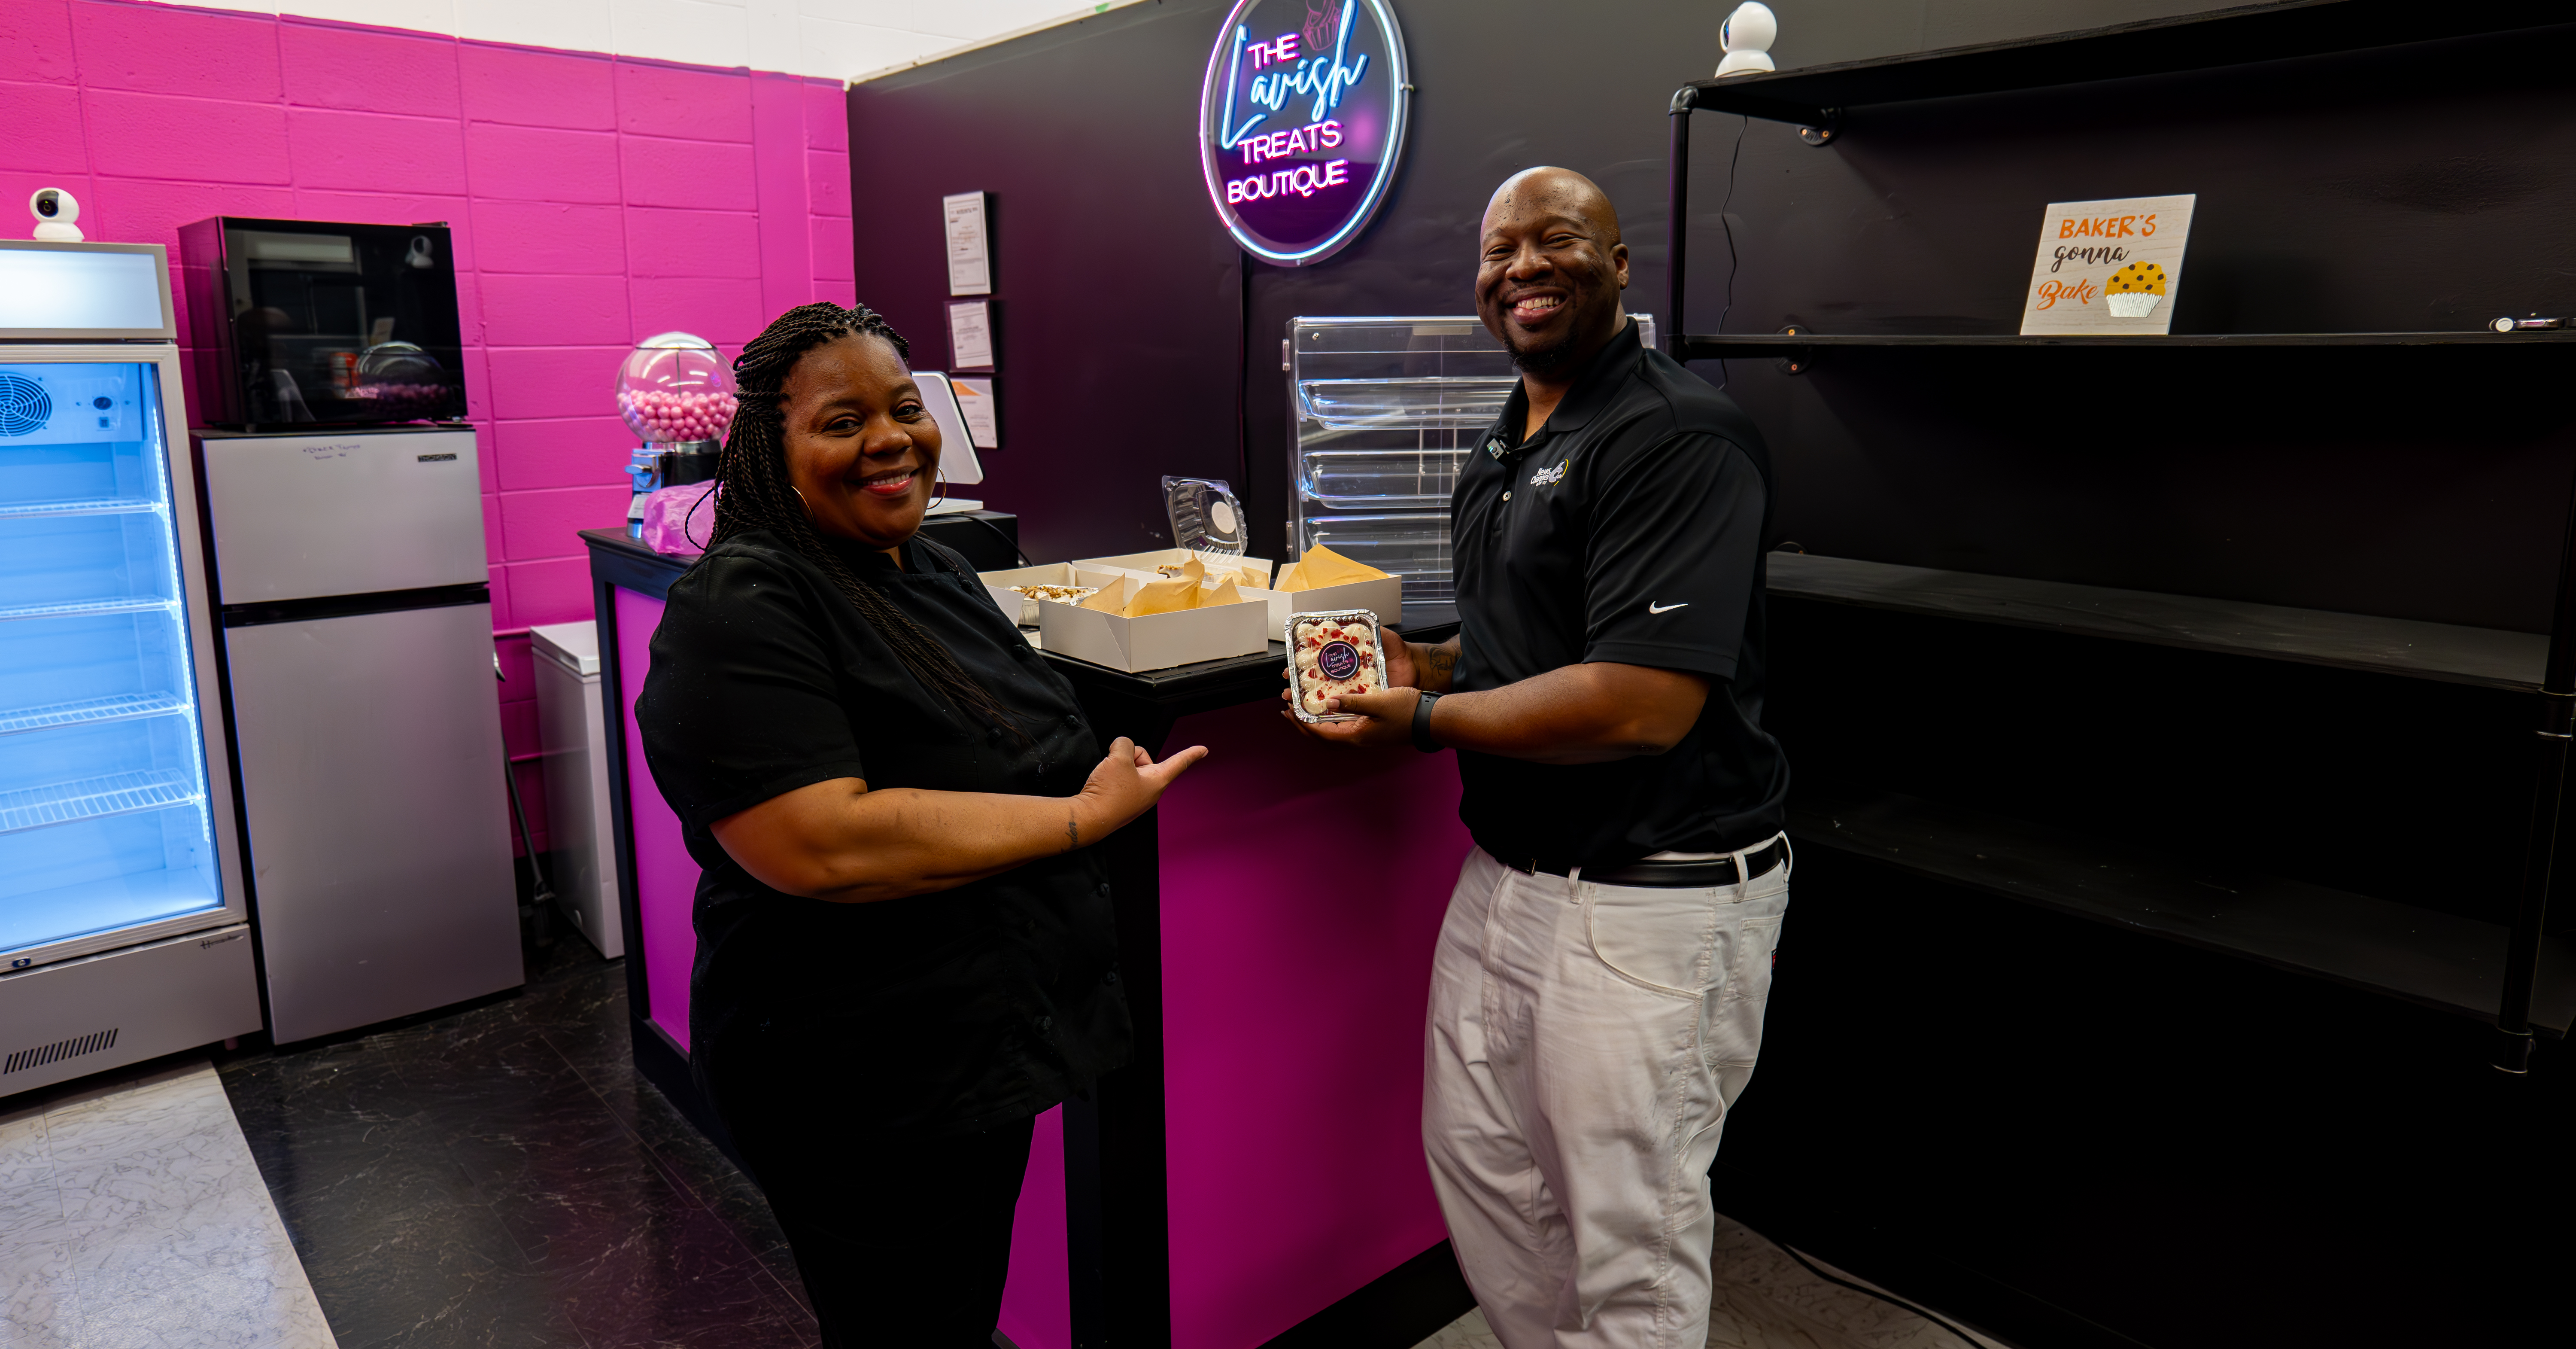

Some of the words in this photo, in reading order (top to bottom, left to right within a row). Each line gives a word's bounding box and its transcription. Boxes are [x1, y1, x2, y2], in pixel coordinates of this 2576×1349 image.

[1248, 33, 1300, 70] THE
[1221, 0, 1370, 149] Lavish
[1238, 120, 1344, 164] TREATS
[1227, 159, 1349, 204] BOUTIQUE
[2059, 214, 2156, 239] BAKER'S
[2051, 246, 2130, 273] gonna
[2037, 279, 2099, 311] Bake
[1530, 472, 1551, 484] Channel
[1537, 468, 1552, 477] News
[1549, 461, 1565, 483] 6
[1325, 647, 1349, 667] Lavish
[1331, 660, 1349, 668] TREATS
[1331, 664, 1351, 673] BOUTIQUE
